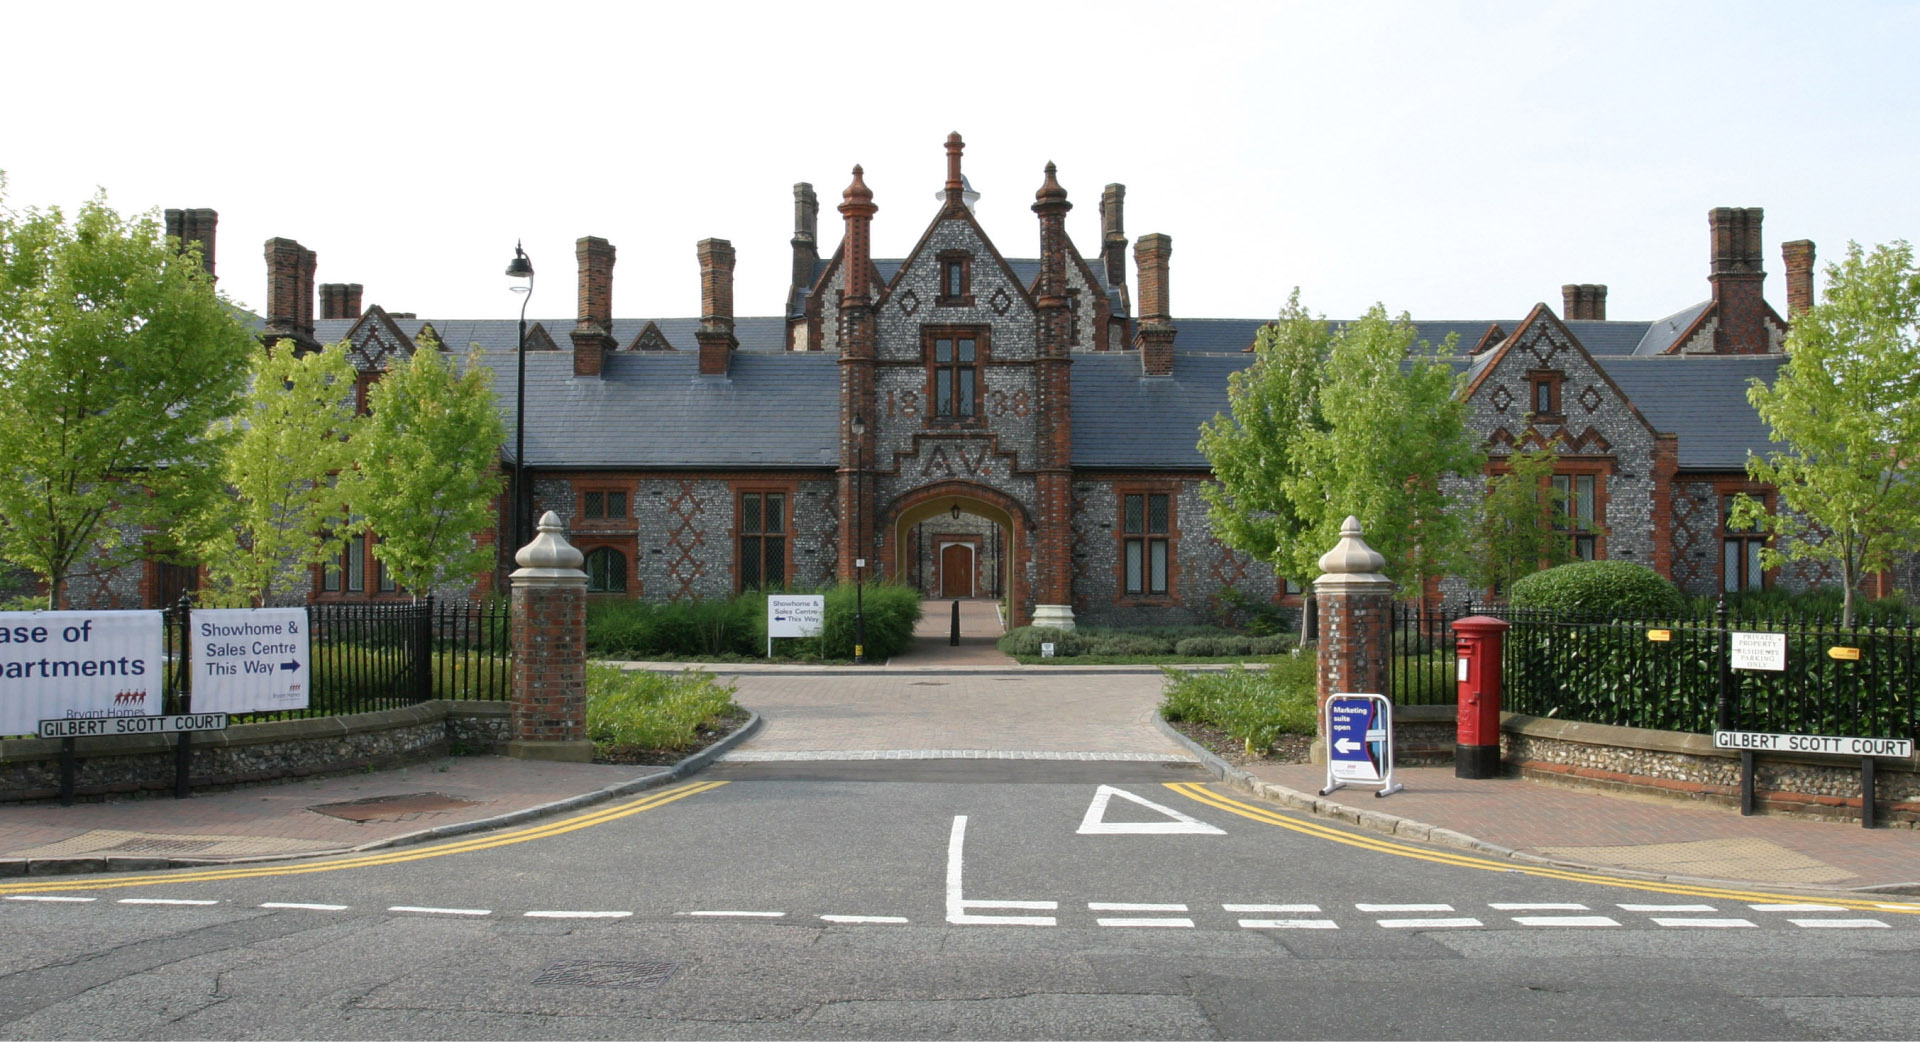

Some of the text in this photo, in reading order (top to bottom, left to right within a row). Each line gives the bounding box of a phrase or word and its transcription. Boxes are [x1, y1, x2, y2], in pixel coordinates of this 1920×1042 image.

[63, 619, 92, 642] of
[201, 621, 298, 637] Showhome &
[206, 641, 296, 657] Sales Centre
[0, 657, 145, 678] artments
[205, 660, 274, 675] This Way
[107, 707, 145, 717] Homes
[1333, 707, 1368, 715] Marketing
[44, 715, 223, 736] GILBERT SCOTT COURT
[1719, 733, 1907, 755] GILBERT SCOTT COURT
